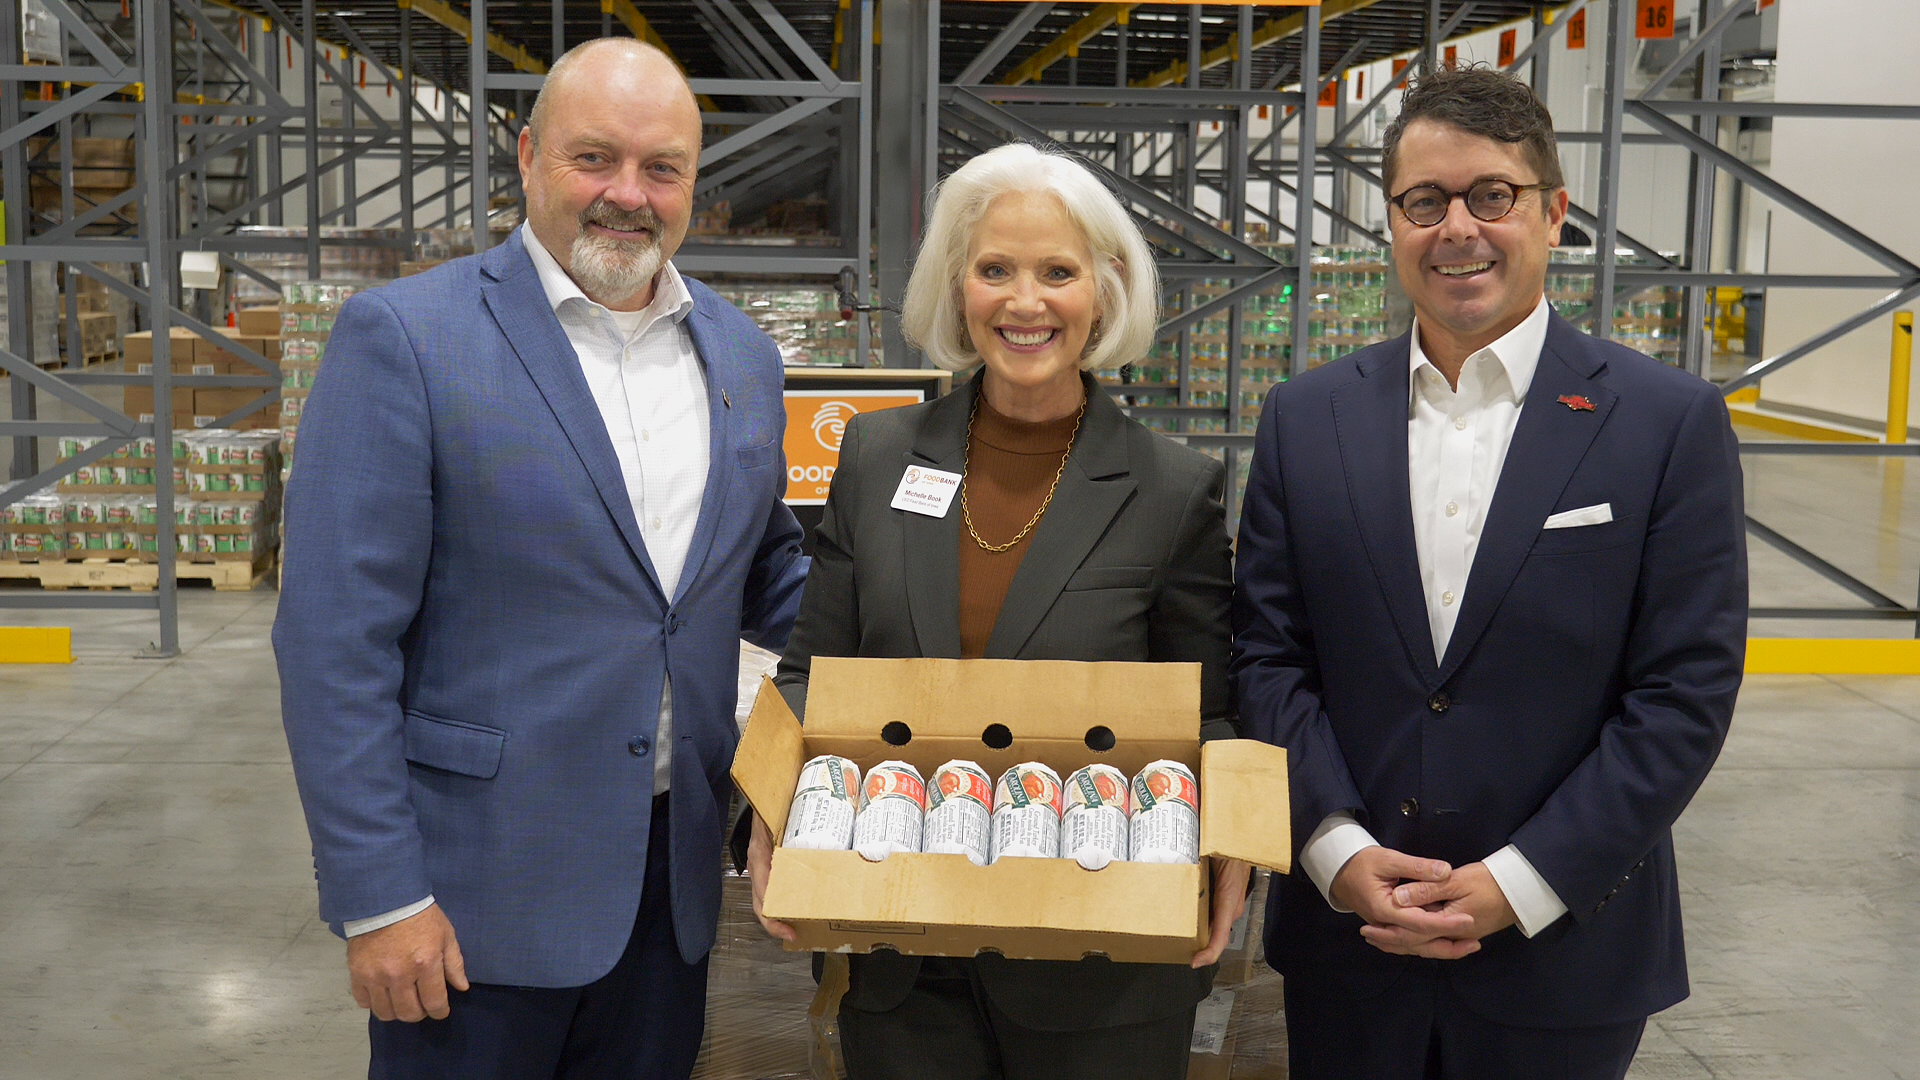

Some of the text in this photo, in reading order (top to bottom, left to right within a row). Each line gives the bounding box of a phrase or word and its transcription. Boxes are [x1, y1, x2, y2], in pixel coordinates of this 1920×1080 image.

[1645, 6, 1667, 28] 16
[787, 465, 837, 482] OOD
[923, 474, 958, 486] FOODBANK
[905, 490, 942, 503] Michelle Book
